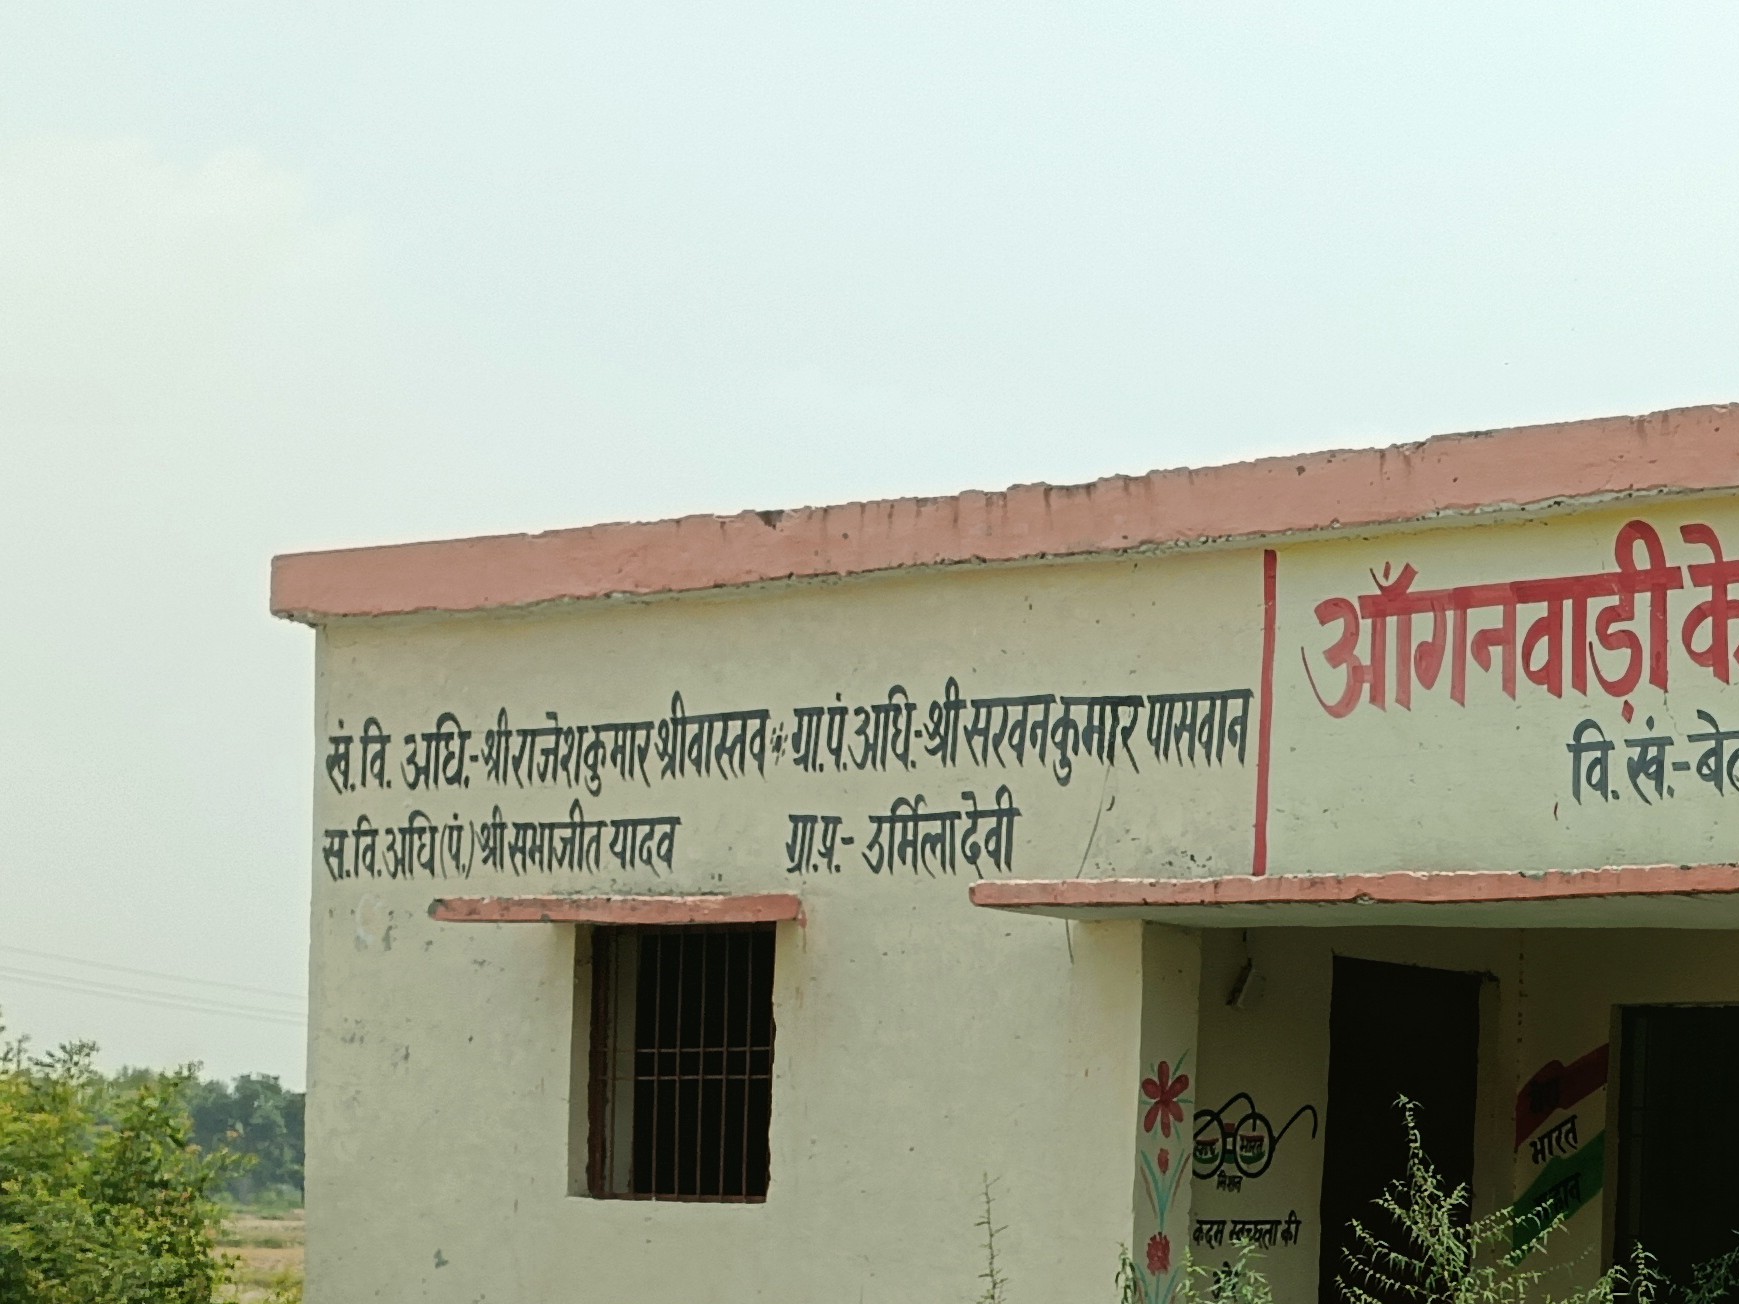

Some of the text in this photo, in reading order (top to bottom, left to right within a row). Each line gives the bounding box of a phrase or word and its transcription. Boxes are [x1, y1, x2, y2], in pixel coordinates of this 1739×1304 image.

[1146, 688, 1254, 768] पासवान
[609, 816, 683, 879] यादव
[961, 784, 1023, 879] देवी
[1529, 1115, 1578, 1165] भारत
